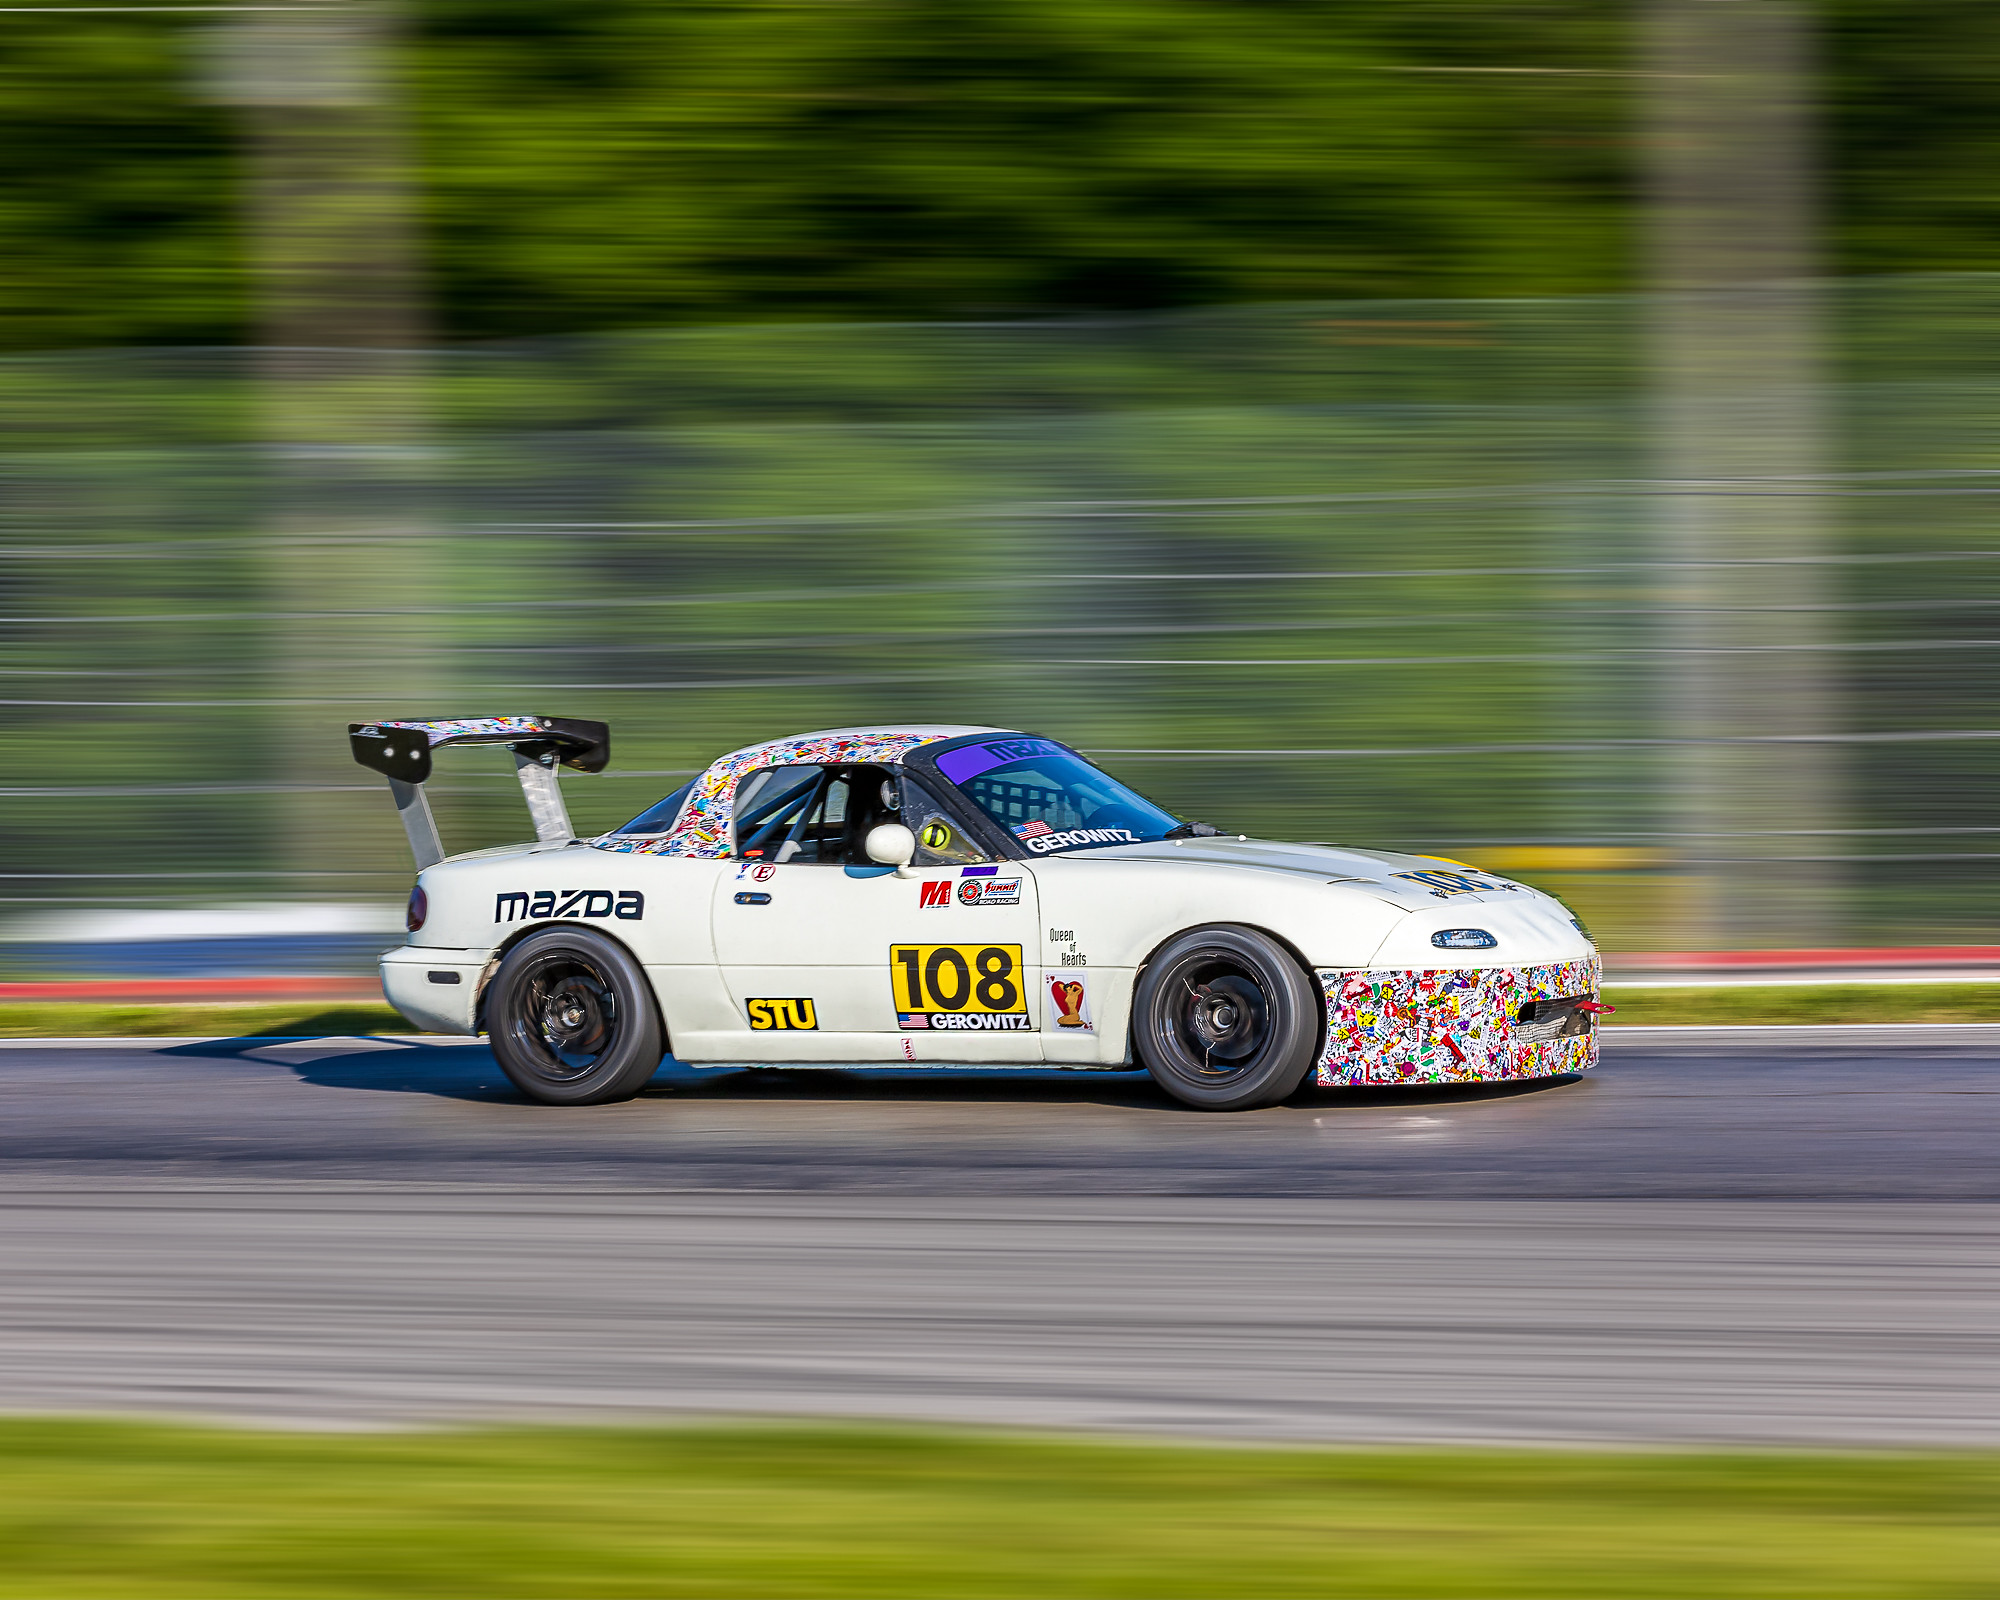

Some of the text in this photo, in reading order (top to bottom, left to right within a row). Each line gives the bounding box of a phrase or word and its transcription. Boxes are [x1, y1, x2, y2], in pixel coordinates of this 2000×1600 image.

[1026, 828, 1141, 853] GEROWITZ
[1050, 928, 1073, 943] Queen
[1070, 942, 1076, 953] of
[1062, 952, 1086, 966] Hearts
[897, 947, 1017, 1010] 108
[748, 999, 816, 1029] STU
[931, 1013, 1030, 1029] GEROWITZ
